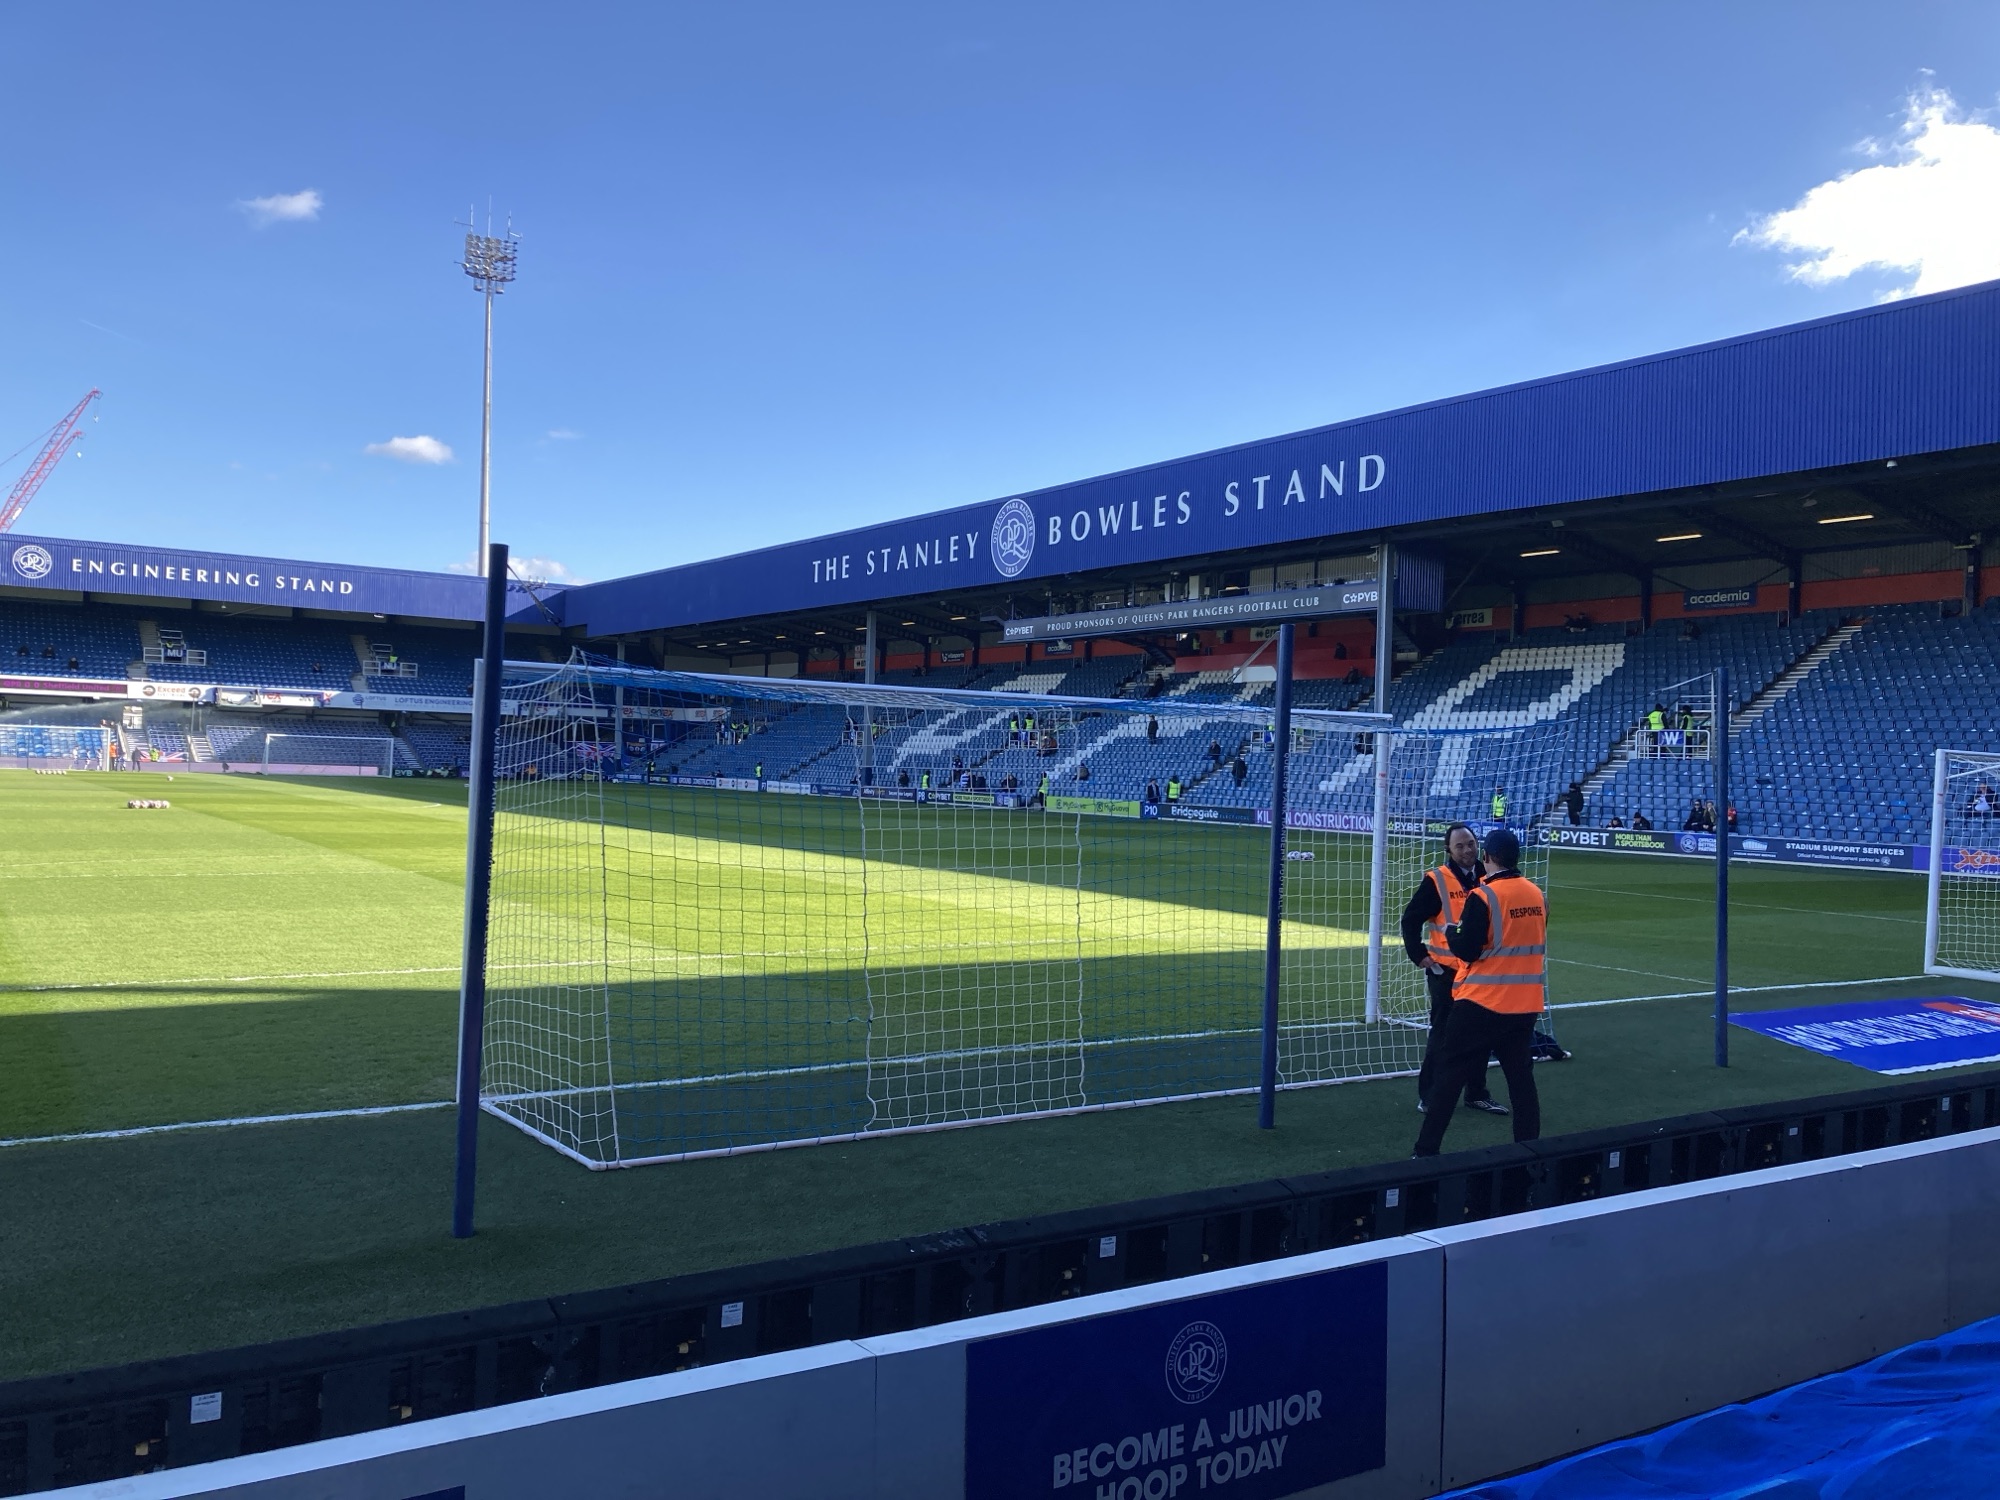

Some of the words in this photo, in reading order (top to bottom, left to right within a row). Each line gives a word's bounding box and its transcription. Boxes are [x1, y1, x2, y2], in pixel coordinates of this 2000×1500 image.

[1048, 491, 1191, 546] BOWLES
[1224, 454, 1386, 517] STAND
[812, 555, 850, 583] THE
[866, 532, 979, 576] STANLEY
[72, 558, 260, 588] ENGINEERING
[276, 576, 353, 594] STAND
[1689, 589, 1750, 604] academia
[1046, 620, 1072, 632] PROUD
[1074, 617, 1114, 629] SPONSORS
[1117, 615, 1128, 625] OF
[1131, 612, 1164, 623] QUEENS
[1167, 609, 1189, 620] PARK
[1193, 602, 1234, 617] RANGERS
[1238, 600, 1288, 613] FOOTBALL
[1293, 597, 1320, 608] CLUB
[1144, 805, 1158, 815] P10
[1171, 806, 1219, 820] Bridgegate
[1294, 811, 1374, 832] CONSTRUCTION
[1615, 833, 1635, 841] MORE
[1621, 840, 1666, 849] SPORTSBOOK
[1785, 842, 1821, 851] STADIUM
[1822, 845, 1860, 853] SUPPORT
[1862, 847, 1905, 856] SERVICES
[1509, 906, 1543, 919] RESPONSE
[1053, 1423, 1185, 1489] BECOME
[1192, 1417, 1214, 1452] A
[1219, 1389, 1322, 1444] JUNIOR
[1096, 1464, 1189, 1500] HOOP
[1196, 1434, 1289, 1490] TODAY
